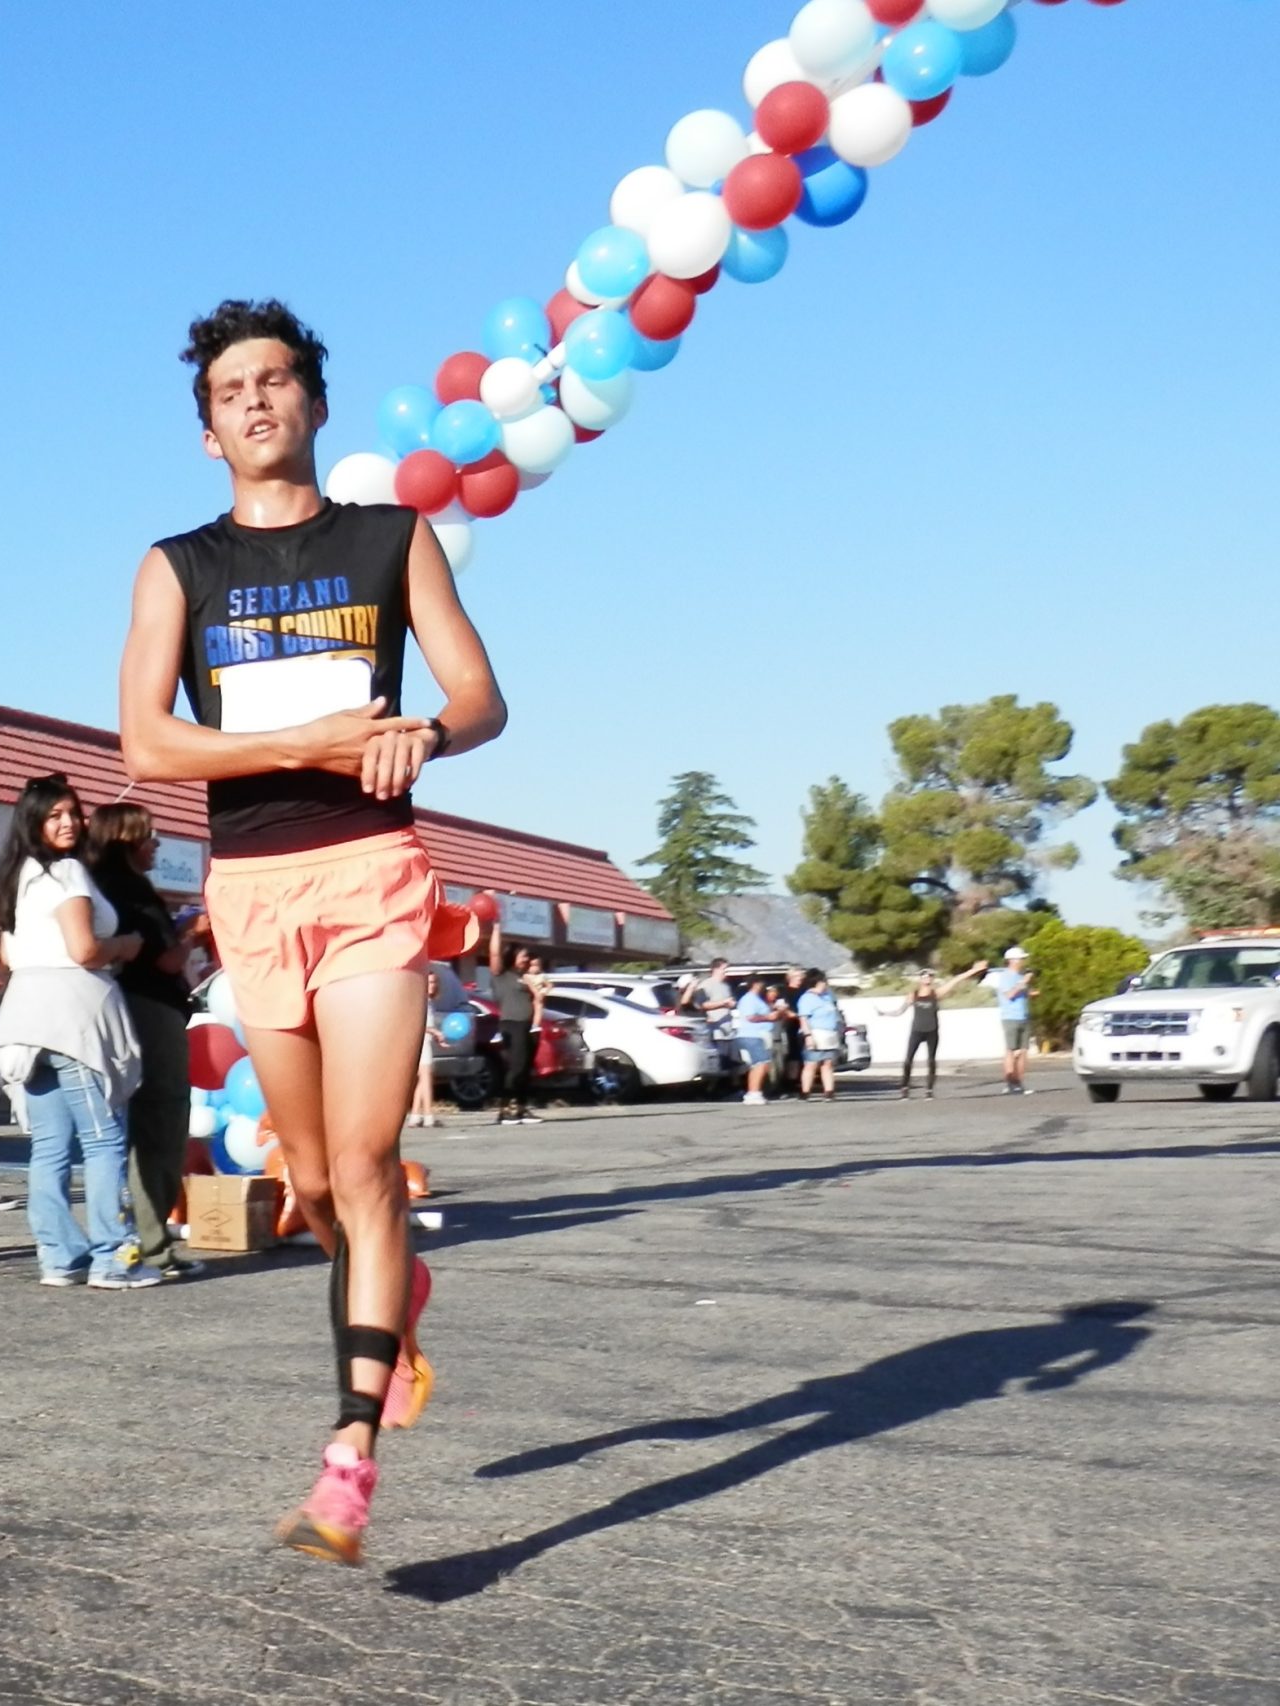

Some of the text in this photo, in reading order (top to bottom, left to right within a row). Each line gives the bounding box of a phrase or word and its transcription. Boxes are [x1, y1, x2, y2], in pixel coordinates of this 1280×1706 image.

[228, 576, 350, 617] SERRANO
[204, 604, 379, 667] CROSS COUNTRY
